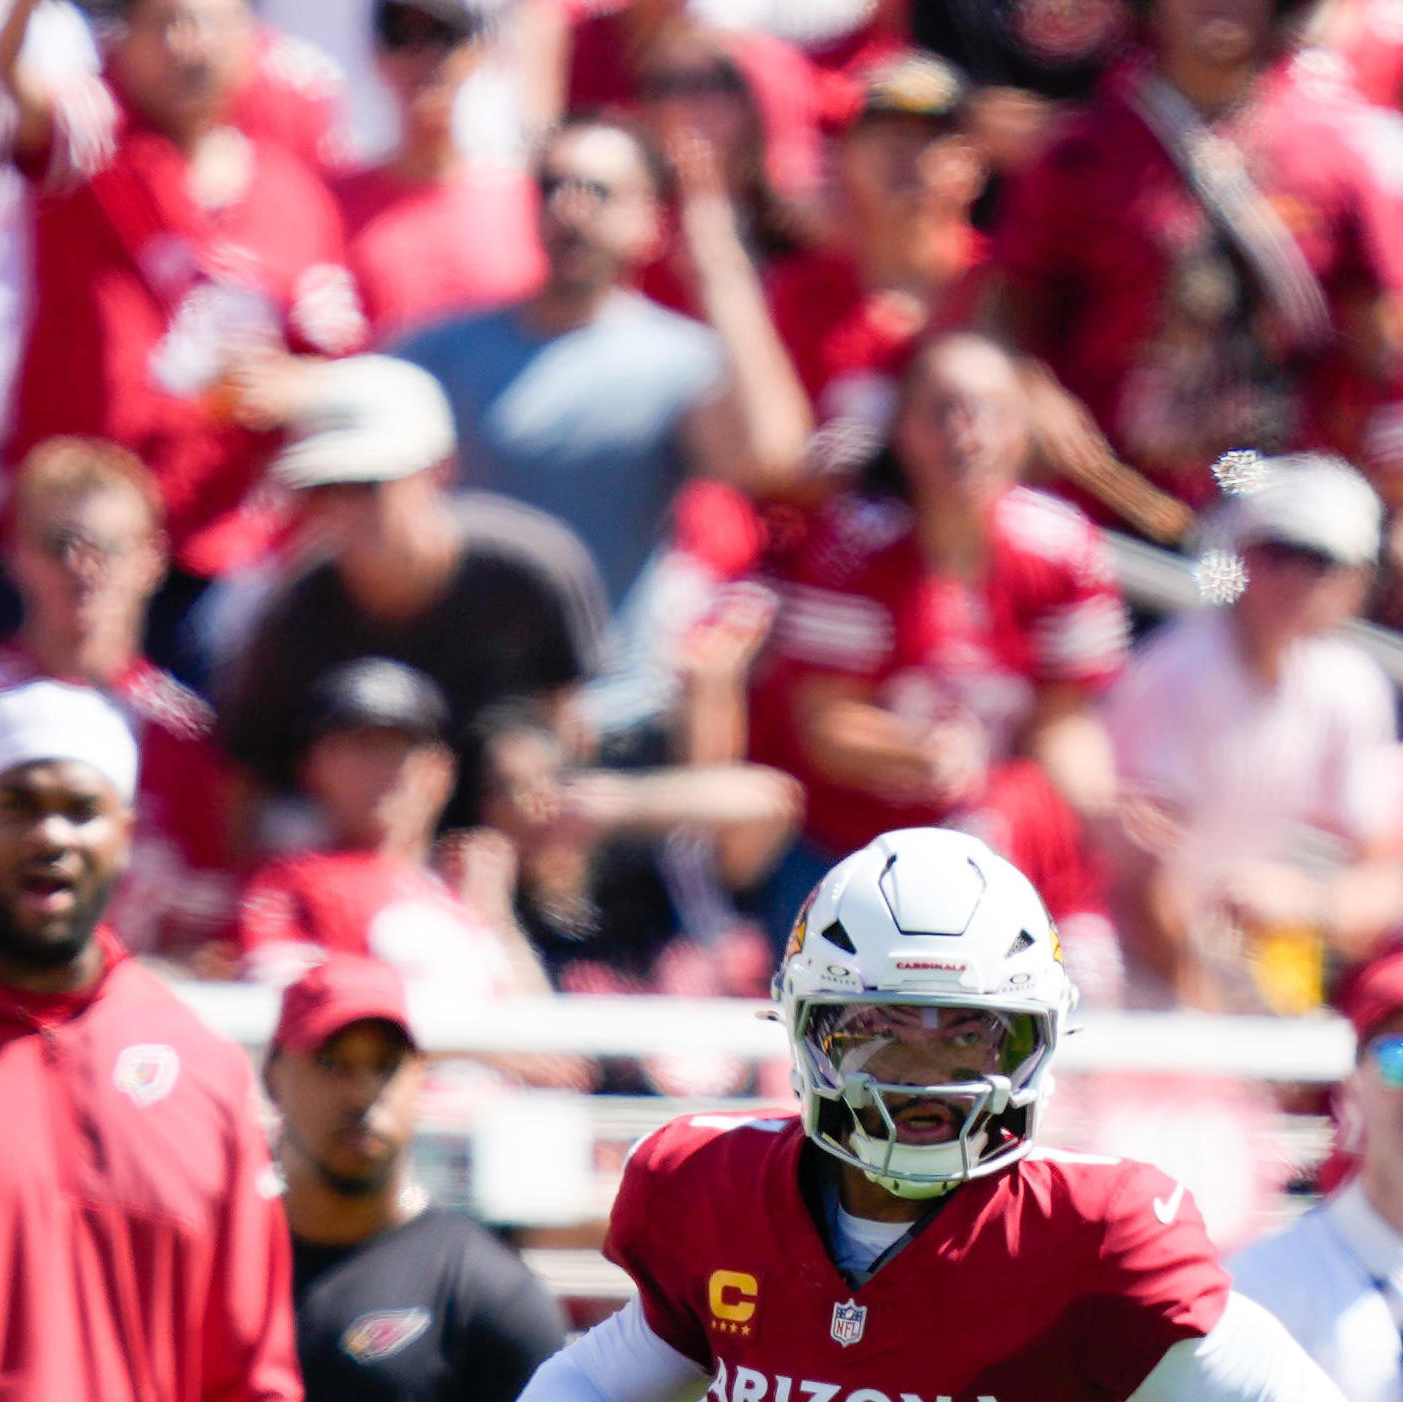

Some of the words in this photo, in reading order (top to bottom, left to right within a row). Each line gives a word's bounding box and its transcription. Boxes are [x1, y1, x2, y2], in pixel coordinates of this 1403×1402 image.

[895, 961, 967, 972] CARDINALS
[708, 1268, 759, 1322] C
[836, 1319, 859, 1338] NFL
